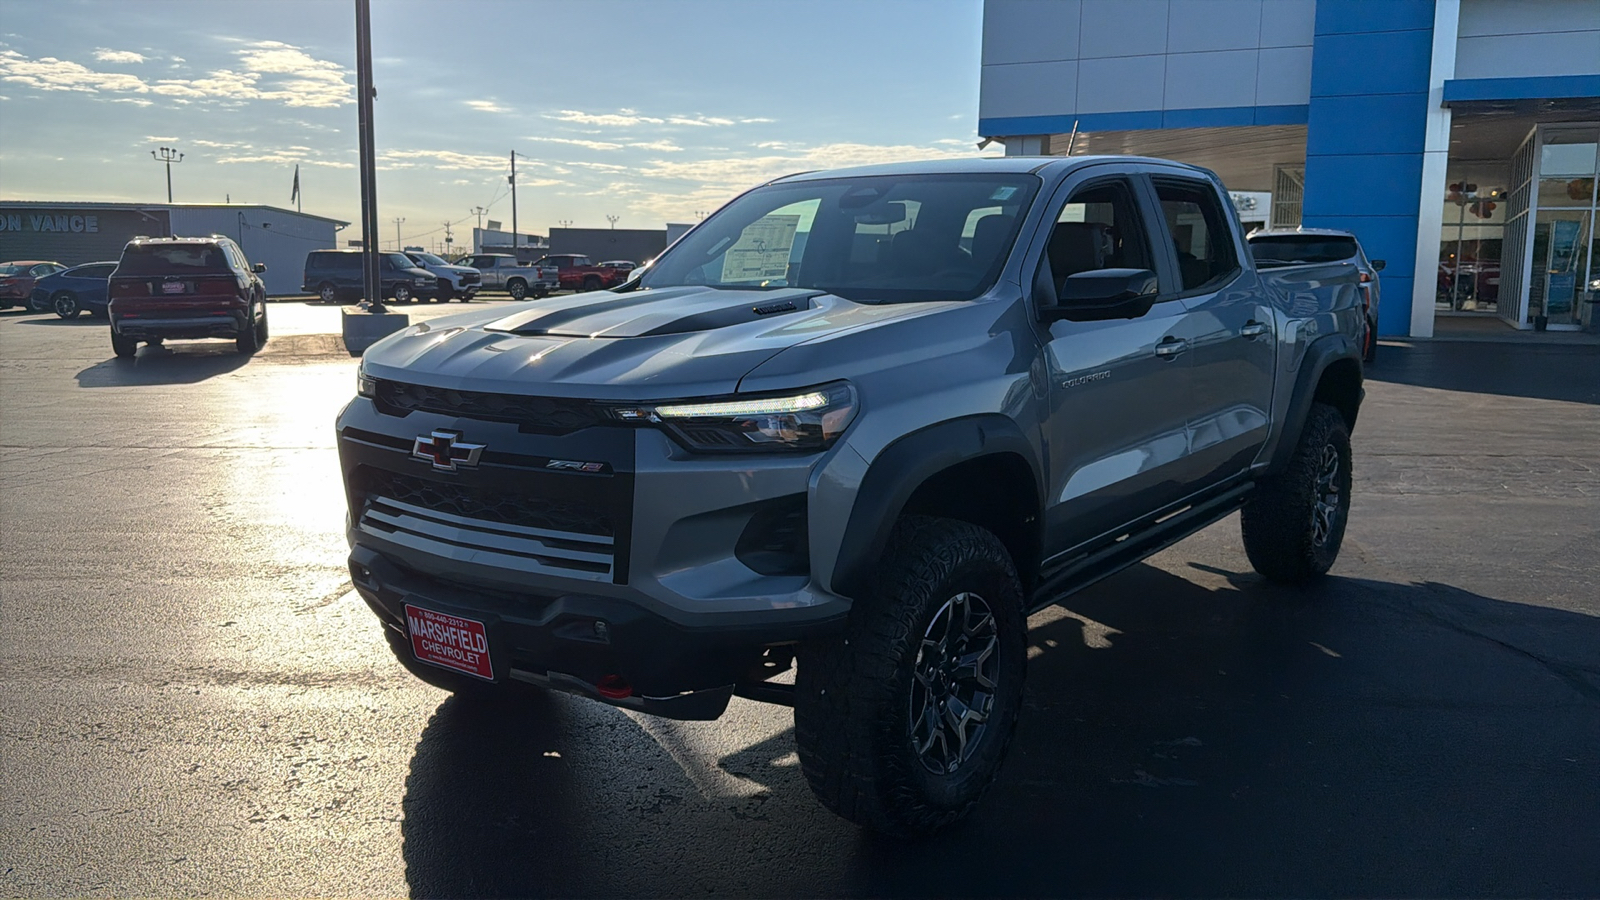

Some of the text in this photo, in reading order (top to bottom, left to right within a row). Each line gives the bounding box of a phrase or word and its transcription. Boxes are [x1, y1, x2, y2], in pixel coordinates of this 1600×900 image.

[30, 214, 98, 233] VANCE
[1062, 370, 1111, 389] COLORADO
[546, 459, 603, 472] ZR2
[408, 616, 487, 654] MARSHFIELD
[421, 639, 480, 665] CHEVROLET
